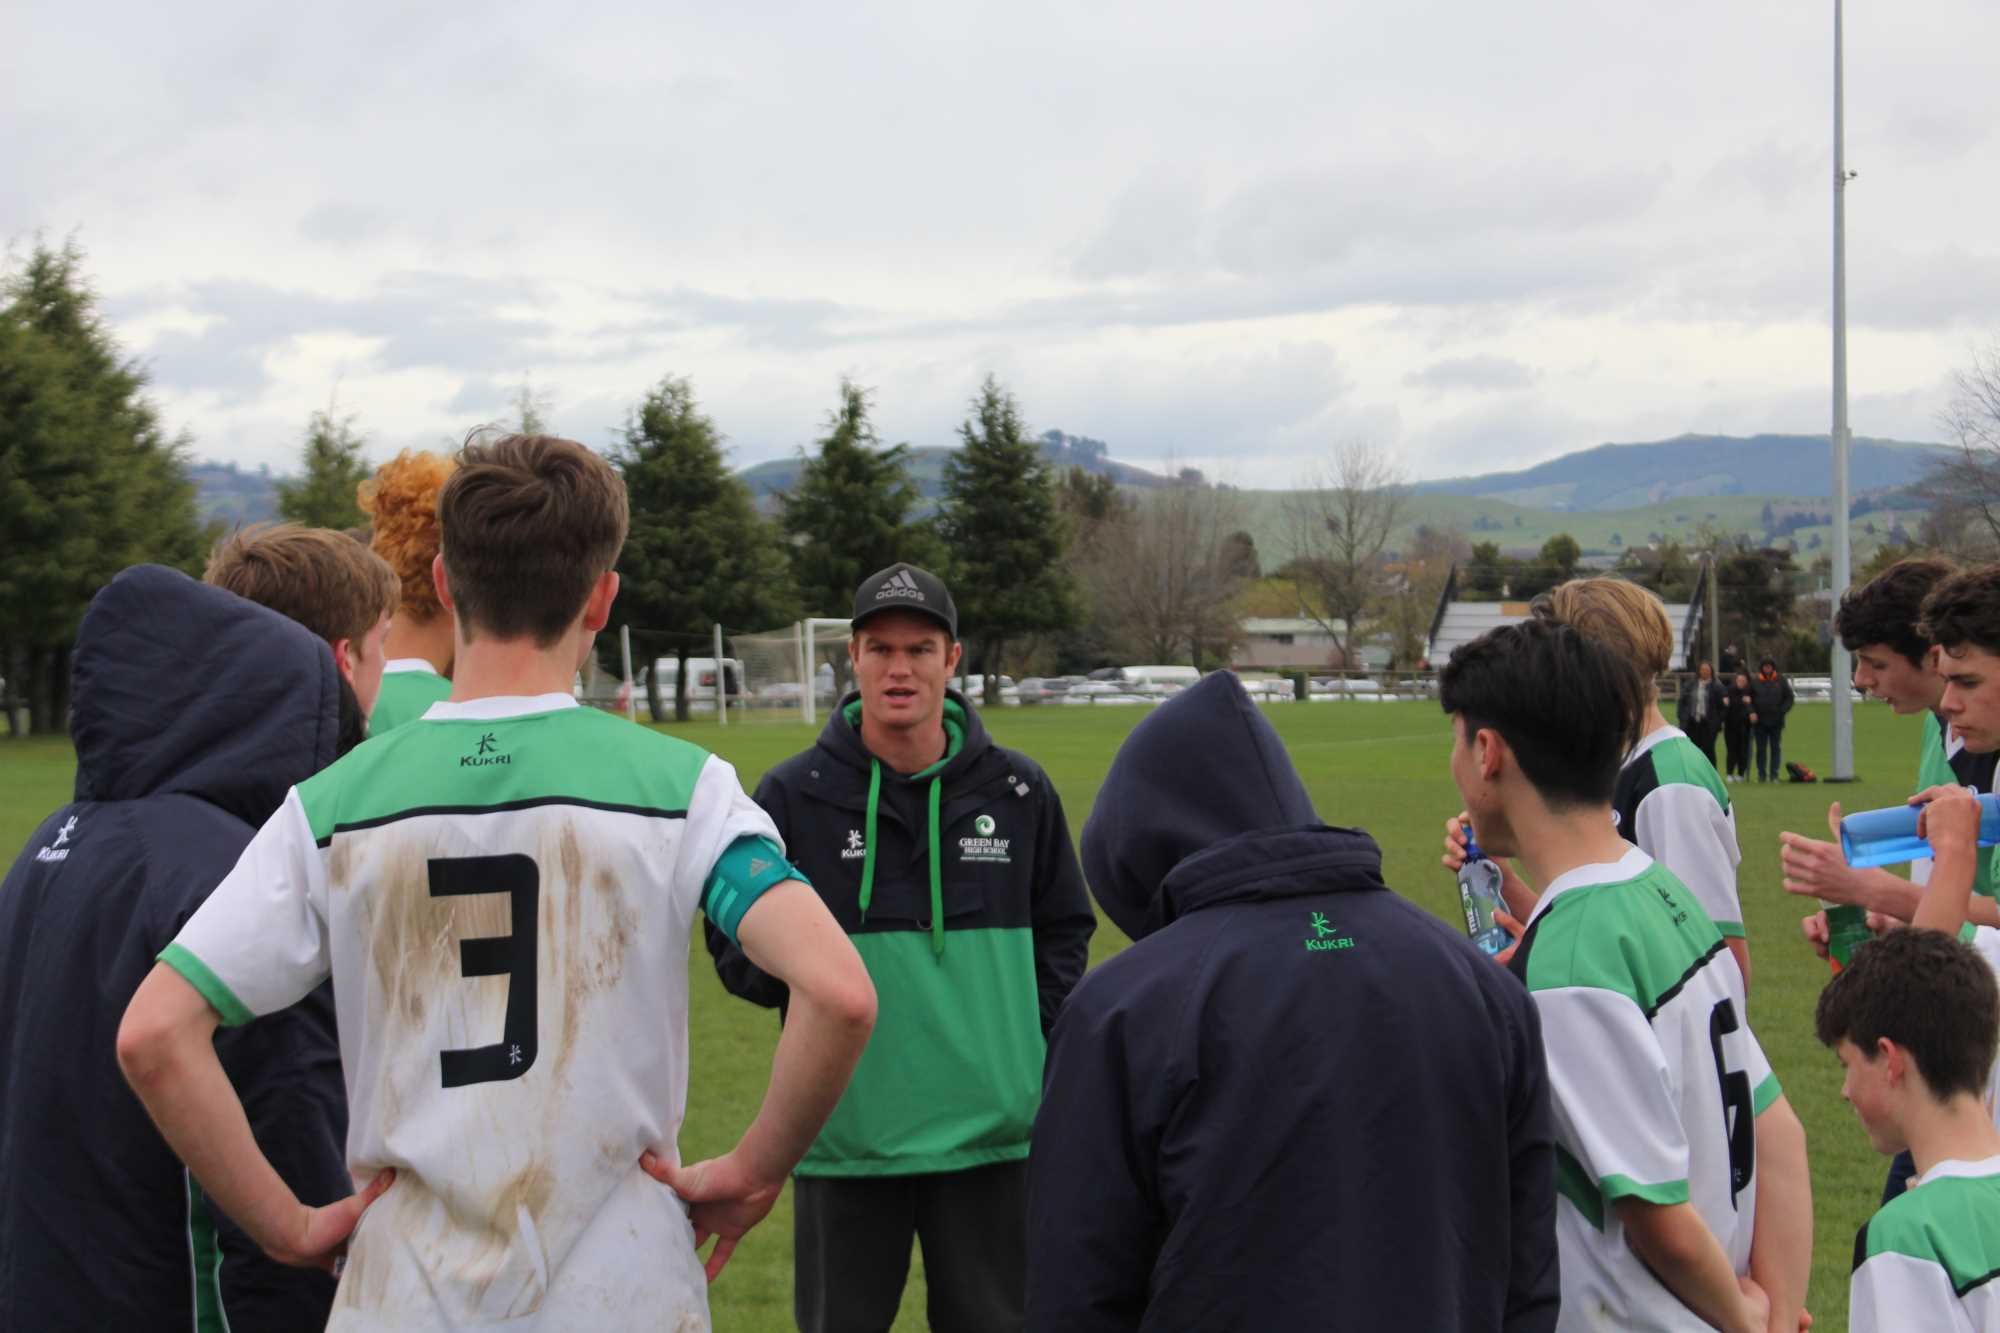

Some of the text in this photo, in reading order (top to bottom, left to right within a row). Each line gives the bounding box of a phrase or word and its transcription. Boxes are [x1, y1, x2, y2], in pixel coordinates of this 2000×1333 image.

[875, 588, 925, 601] adidas
[460, 754, 512, 767] KUKRI
[959, 838, 1010, 848] GREEN BAY
[1305, 938, 1354, 951] KUKRI
[427, 853, 540, 1088] 3
[1710, 997, 1754, 1212] 6
